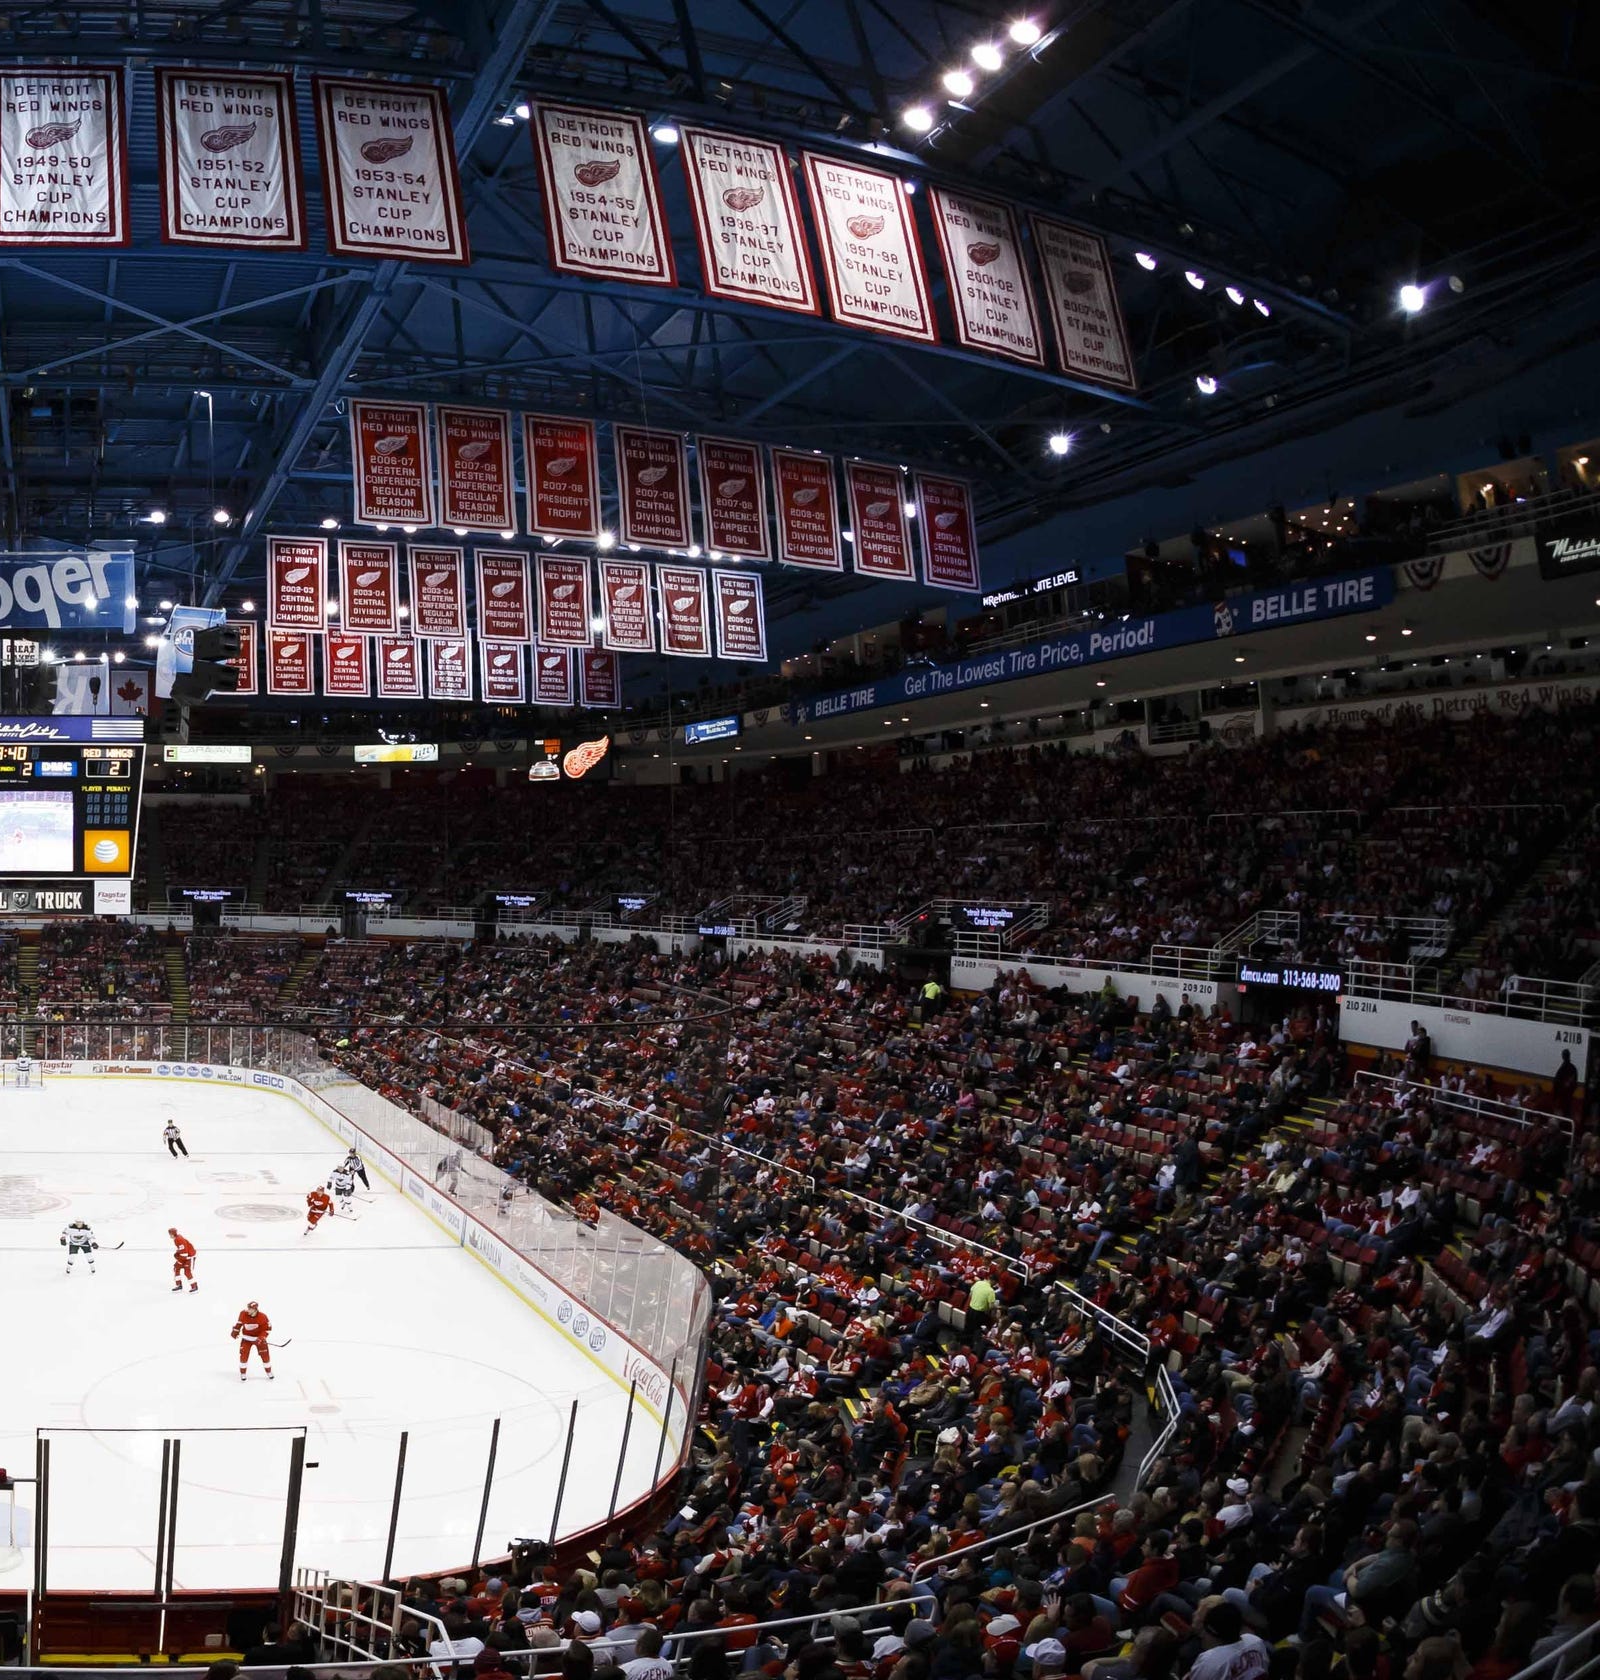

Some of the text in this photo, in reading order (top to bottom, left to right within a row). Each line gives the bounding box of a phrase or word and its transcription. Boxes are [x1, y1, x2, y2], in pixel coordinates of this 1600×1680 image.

[15, 85, 92, 96] DETROIT
[188, 85, 263, 99] DETROIT
[6, 101, 102, 113] RED WINGS
[181, 100, 274, 118] RED WINGS
[556, 117, 624, 138] DETROIT
[552, 133, 634, 157] RED WINGS
[17, 156, 91, 169] 1949-50
[196, 159, 265, 173] 1951-52
[13, 173, 94, 186] STANLEY
[191, 177, 271, 192] STANLEY
[37, 191, 72, 203] CUP
[215, 196, 251, 209] CUP
[570, 191, 635, 210] 1954-55
[4, 210, 106, 223] CHAMPIONS
[184, 213, 284, 230] CHAMPIONS
[570, 208, 639, 227] STANLEY
[593, 229, 624, 241] CUP
[568, 242, 655, 267] CHAMPIONS
[367, 413, 410, 422] DETROIT
[363, 422, 416, 434] RED WINGS
[370, 455, 414, 466] 2006-07
[371, 466, 415, 476] WESTERN
[365, 475, 421, 487] CONFERENCE
[373, 486, 416, 497] REGULAR
[375, 497, 414, 507] SEASON
[366, 507, 424, 519] CHAMPIONS
[280, 547, 314, 555] DETROIT
[277, 555, 317, 564] RED WINGS
[1053, 570, 1078, 587] LEVEL
[281, 586, 314, 594] 2002-03
[281, 595, 313, 603] CENTRAL
[1252, 576, 1374, 623] BELLE TIRE
[280, 604, 314, 612] DIVISION
[277, 614, 318, 622] CHAMPIONS
[904, 621, 1155, 695] Get The Lowest Tire Price, Period!
[815, 688, 875, 716] BELLE TIRE
[1433, 694, 1488, 714] Detroit
[1497, 686, 1529, 710] Red
[1538, 684, 1592, 707] Wings
[84, 749, 133, 758] RED WINGS
[22, 762, 32, 776] 2
[42, 762, 72, 772] DMC
[110, 761, 120, 776] 2
[36, 892, 82, 909] TRUCK
[98, 891, 126, 900] Flagstar
[1241, 968, 1340, 992] dmcu.com 313-568-5000
[1346, 1000, 1359, 1011] 210
[253, 1073, 284, 1089] GEICO
